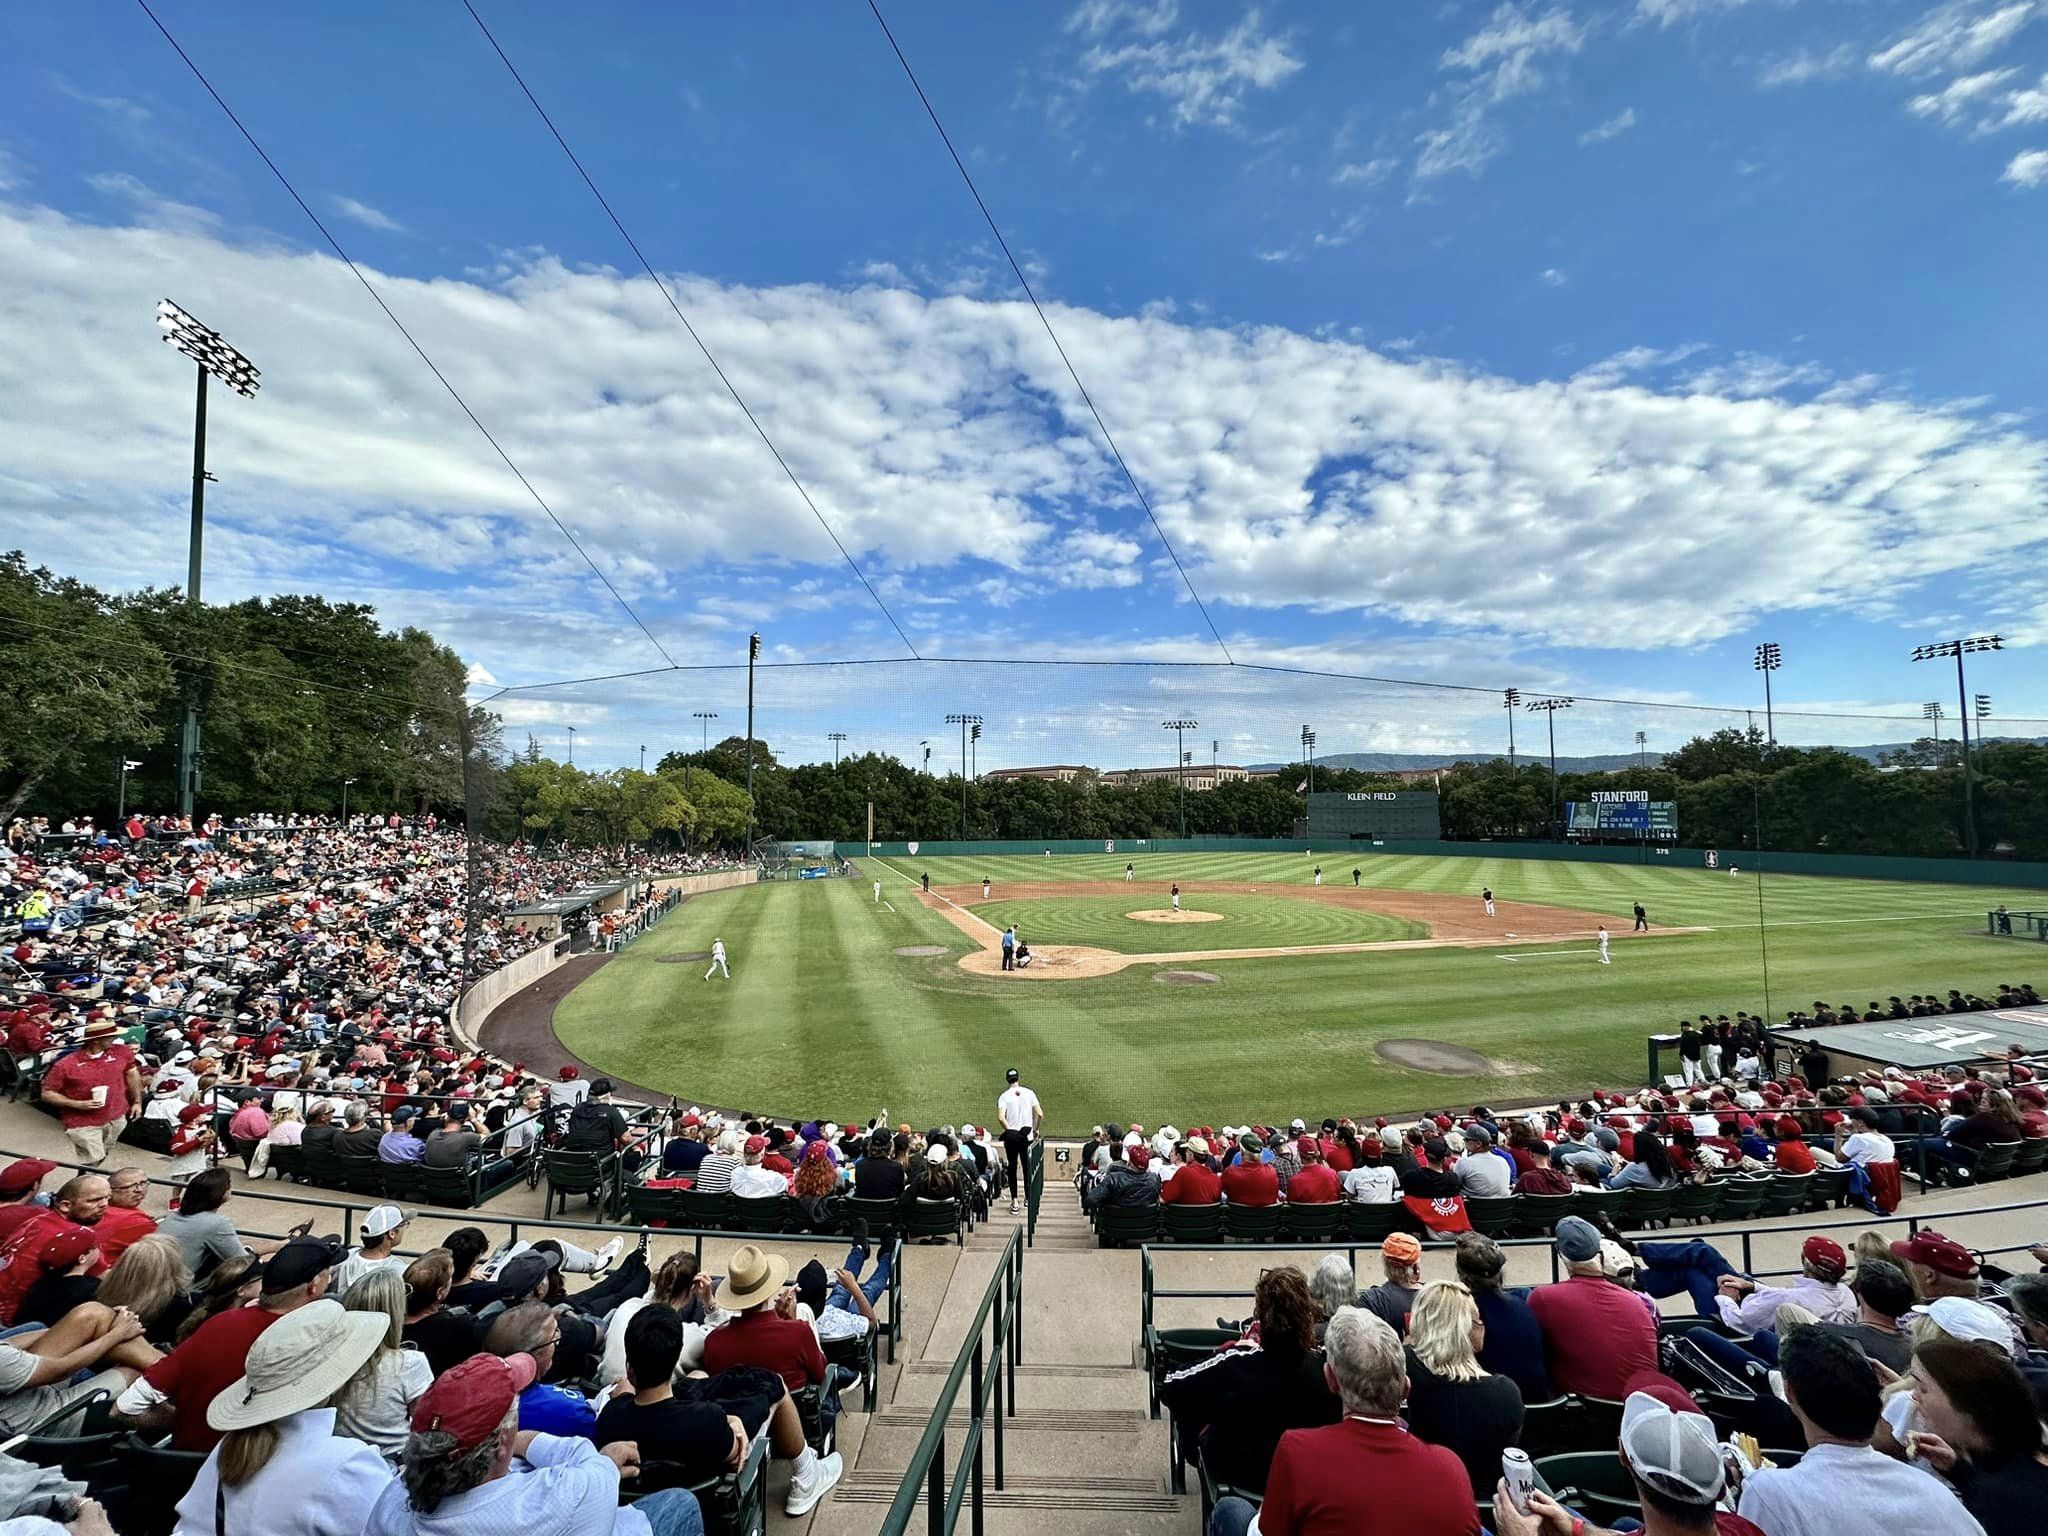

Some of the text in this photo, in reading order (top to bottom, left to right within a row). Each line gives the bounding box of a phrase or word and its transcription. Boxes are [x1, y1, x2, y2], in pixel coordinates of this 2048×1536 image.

[1347, 792, 1396, 800] KLEIN FIELD
[1591, 791, 1648, 802] STANFORD
[1057, 1151, 1067, 1161] 4
